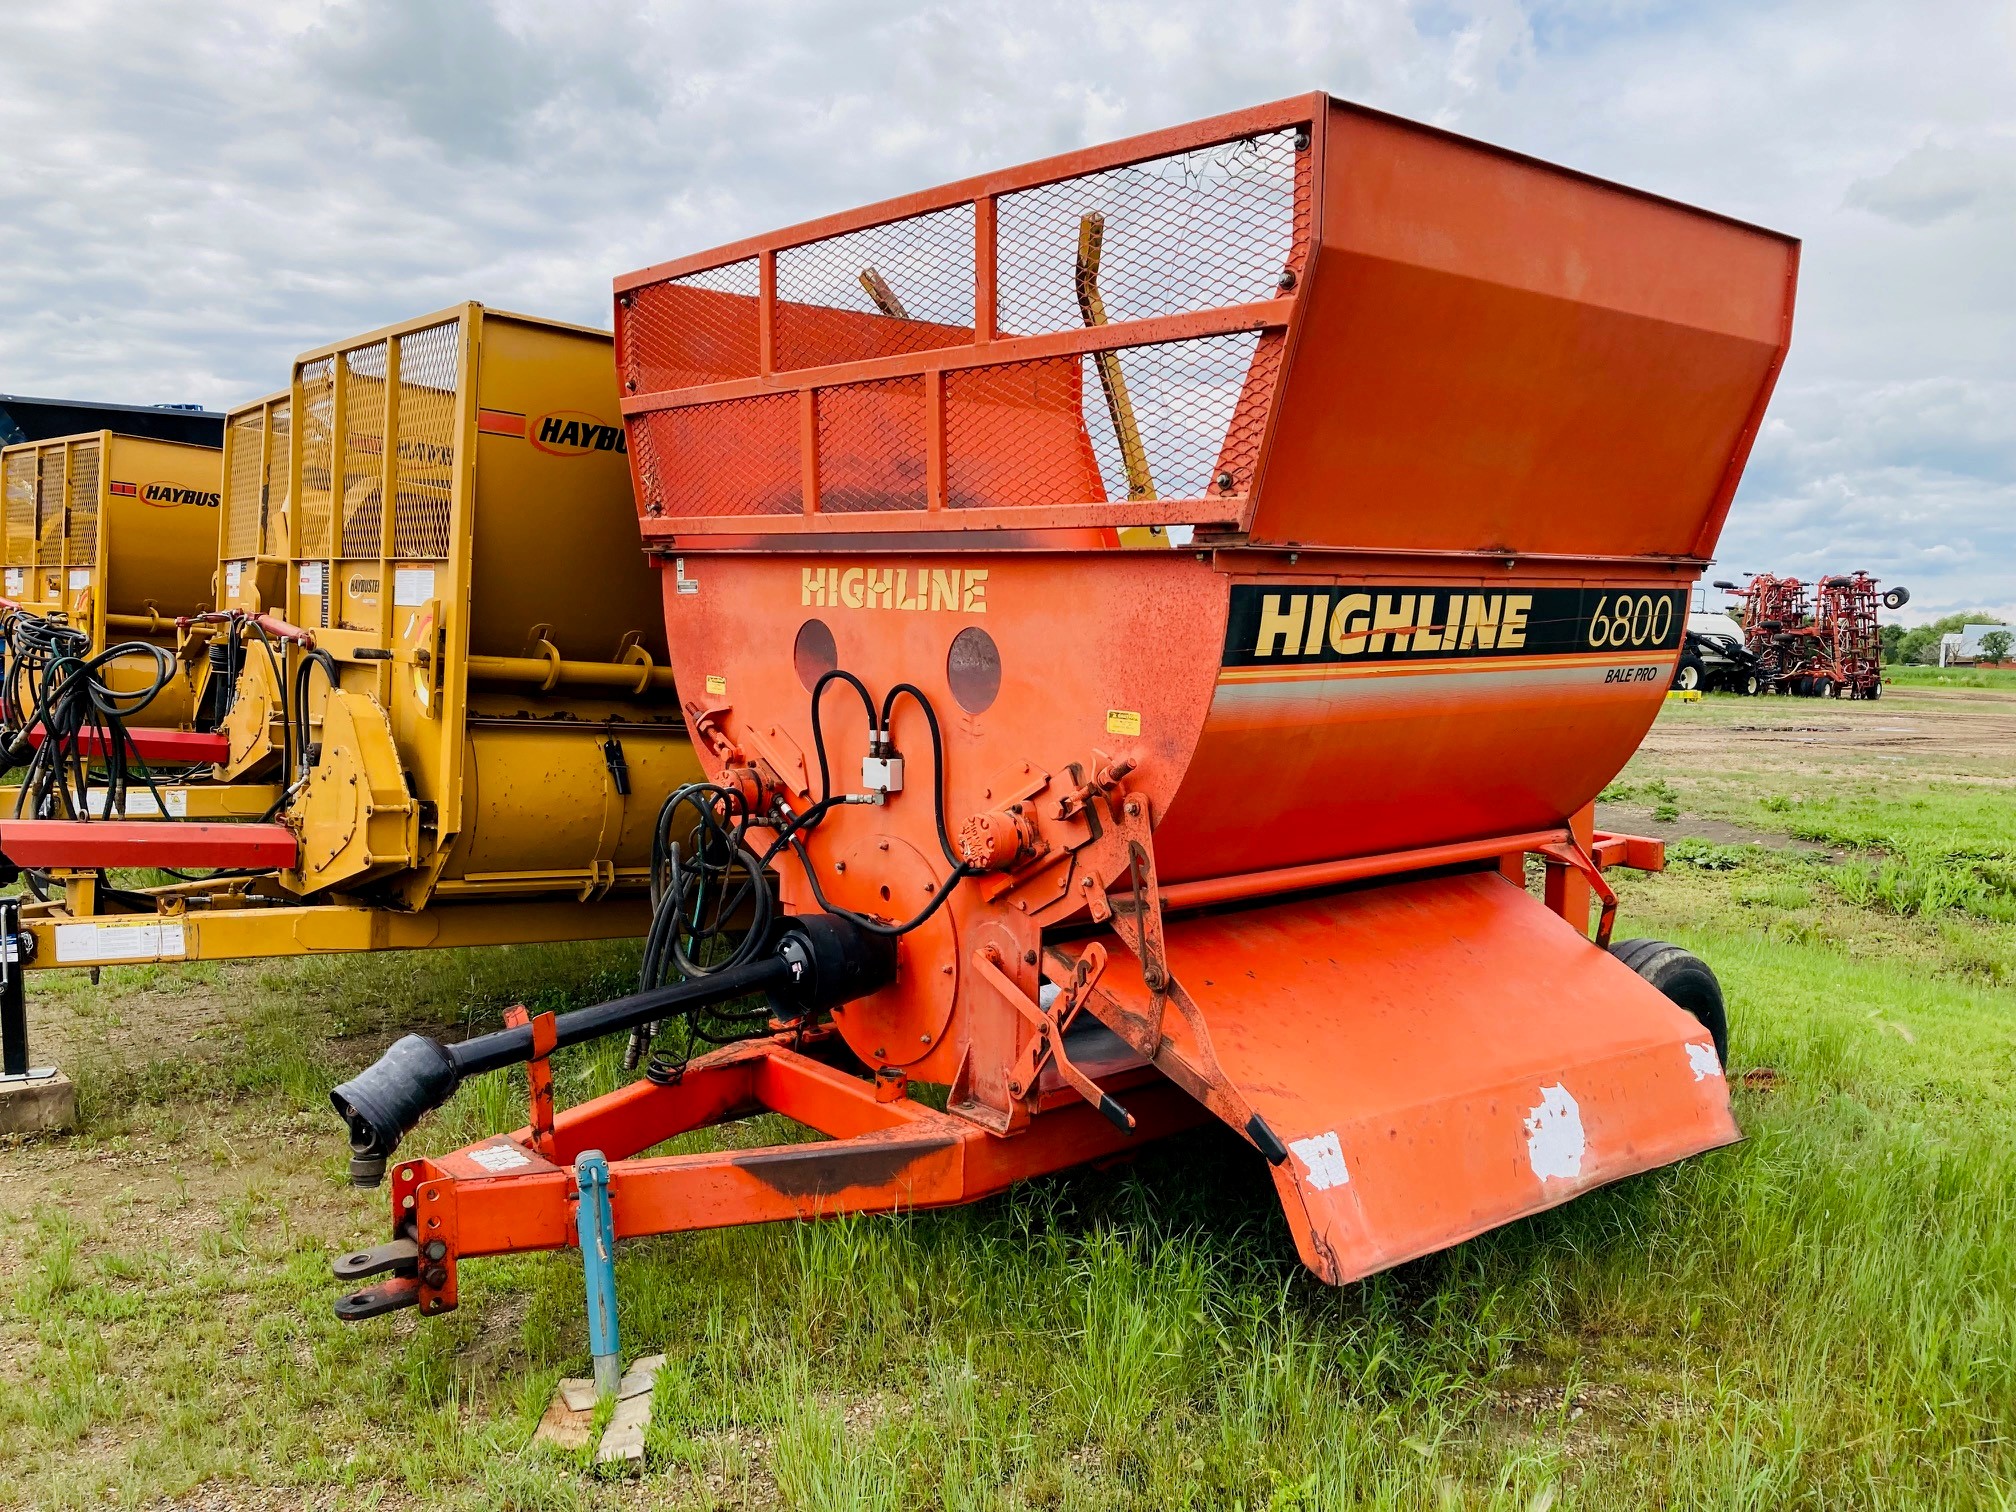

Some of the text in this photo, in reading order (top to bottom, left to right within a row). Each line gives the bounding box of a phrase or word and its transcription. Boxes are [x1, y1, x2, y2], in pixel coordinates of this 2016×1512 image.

[801, 567, 989, 613] HIGHLINE
[1254, 594, 1673, 657] HIGHLINE 6800
[1604, 666, 1658, 684] BALE PRO
